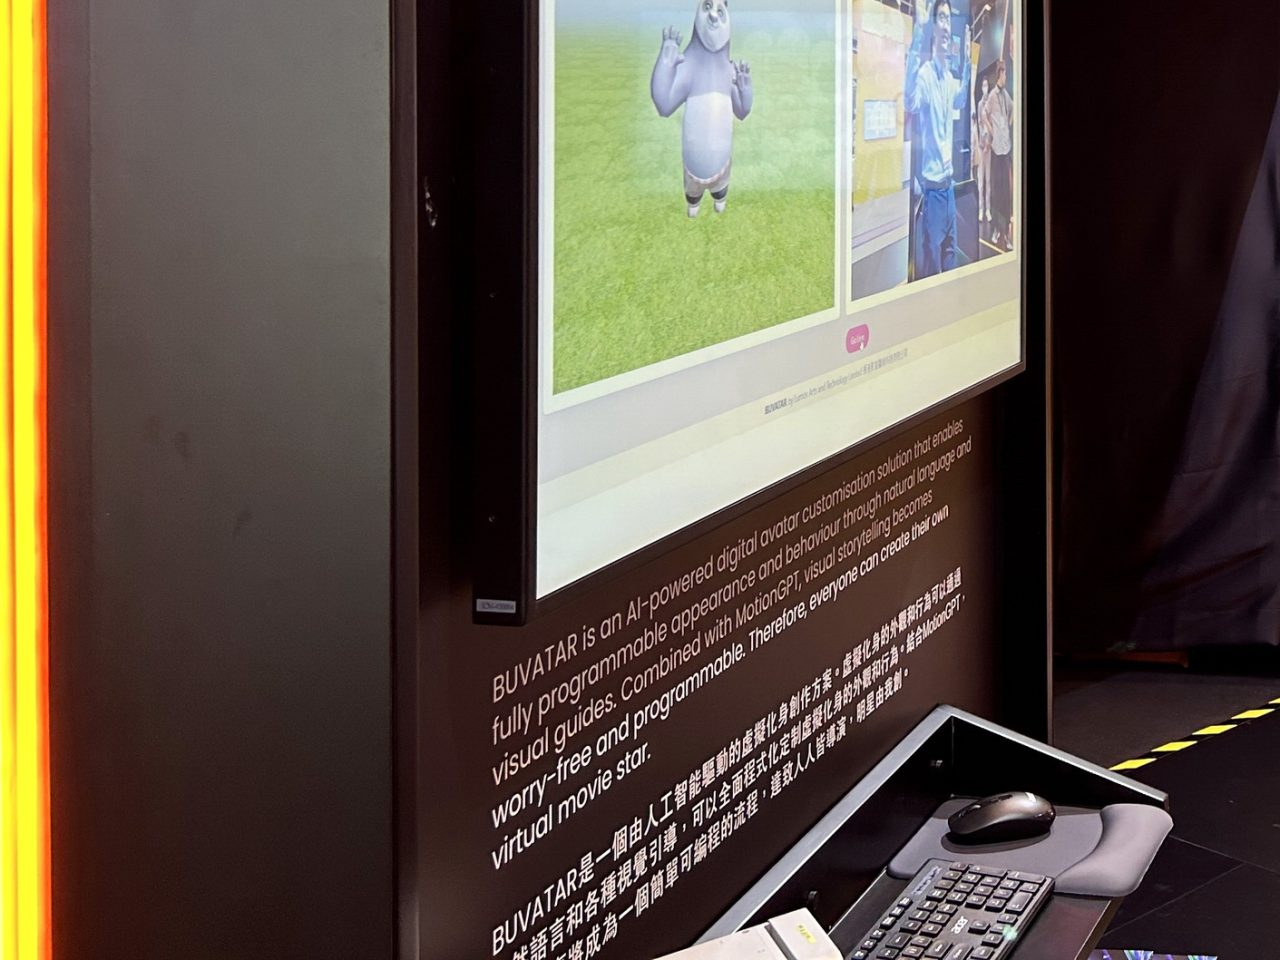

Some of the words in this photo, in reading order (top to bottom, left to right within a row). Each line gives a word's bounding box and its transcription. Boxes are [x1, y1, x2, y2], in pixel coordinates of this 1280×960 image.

[490, 744, 592, 829] worry-free
[596, 713, 629, 757] and
[633, 643, 746, 740] programmable.
[748, 601, 808, 652] Therefore,
[809, 566, 858, 611] everyone
[859, 549, 879, 577] can
[880, 529, 910, 563] create
[911, 514, 930, 541] their
[931, 504, 949, 528] own
[491, 731, 549, 786] visual
[553, 692, 617, 754] guides.
[621, 632, 701, 701] Combined
[704, 615, 733, 648] with
[735, 570, 802, 629] MotionGPT,
[803, 547, 836, 584] visual
[837, 519, 891, 563] storytelling
[892, 489, 933, 527] becomes
[492, 632, 577, 704] BUVATAR
[582, 625, 596, 651] is
[600, 612, 622, 640] an
[626, 554, 713, 627] AI-powered
[716, 530, 757, 573] digital
[760, 510, 801, 547] avatar
[801, 468, 876, 525] customisation
[877, 446, 912, 480] solution
[913, 437, 932, 459] that
[932, 418, 964, 448] enables
[492, 700, 533, 746] fully
[538, 621, 667, 727] programmable
[670, 569, 756, 637] appearance
[758, 547, 783, 581] and
[785, 519, 841, 565] behaviour
[843, 493, 882, 530] through
[883, 468, 916, 506] natural
[916, 452, 956, 485] language
[956, 435, 972, 460] and
[490, 803, 553, 870] virtual
[557, 767, 613, 825] movie
[615, 740, 651, 777] star.
